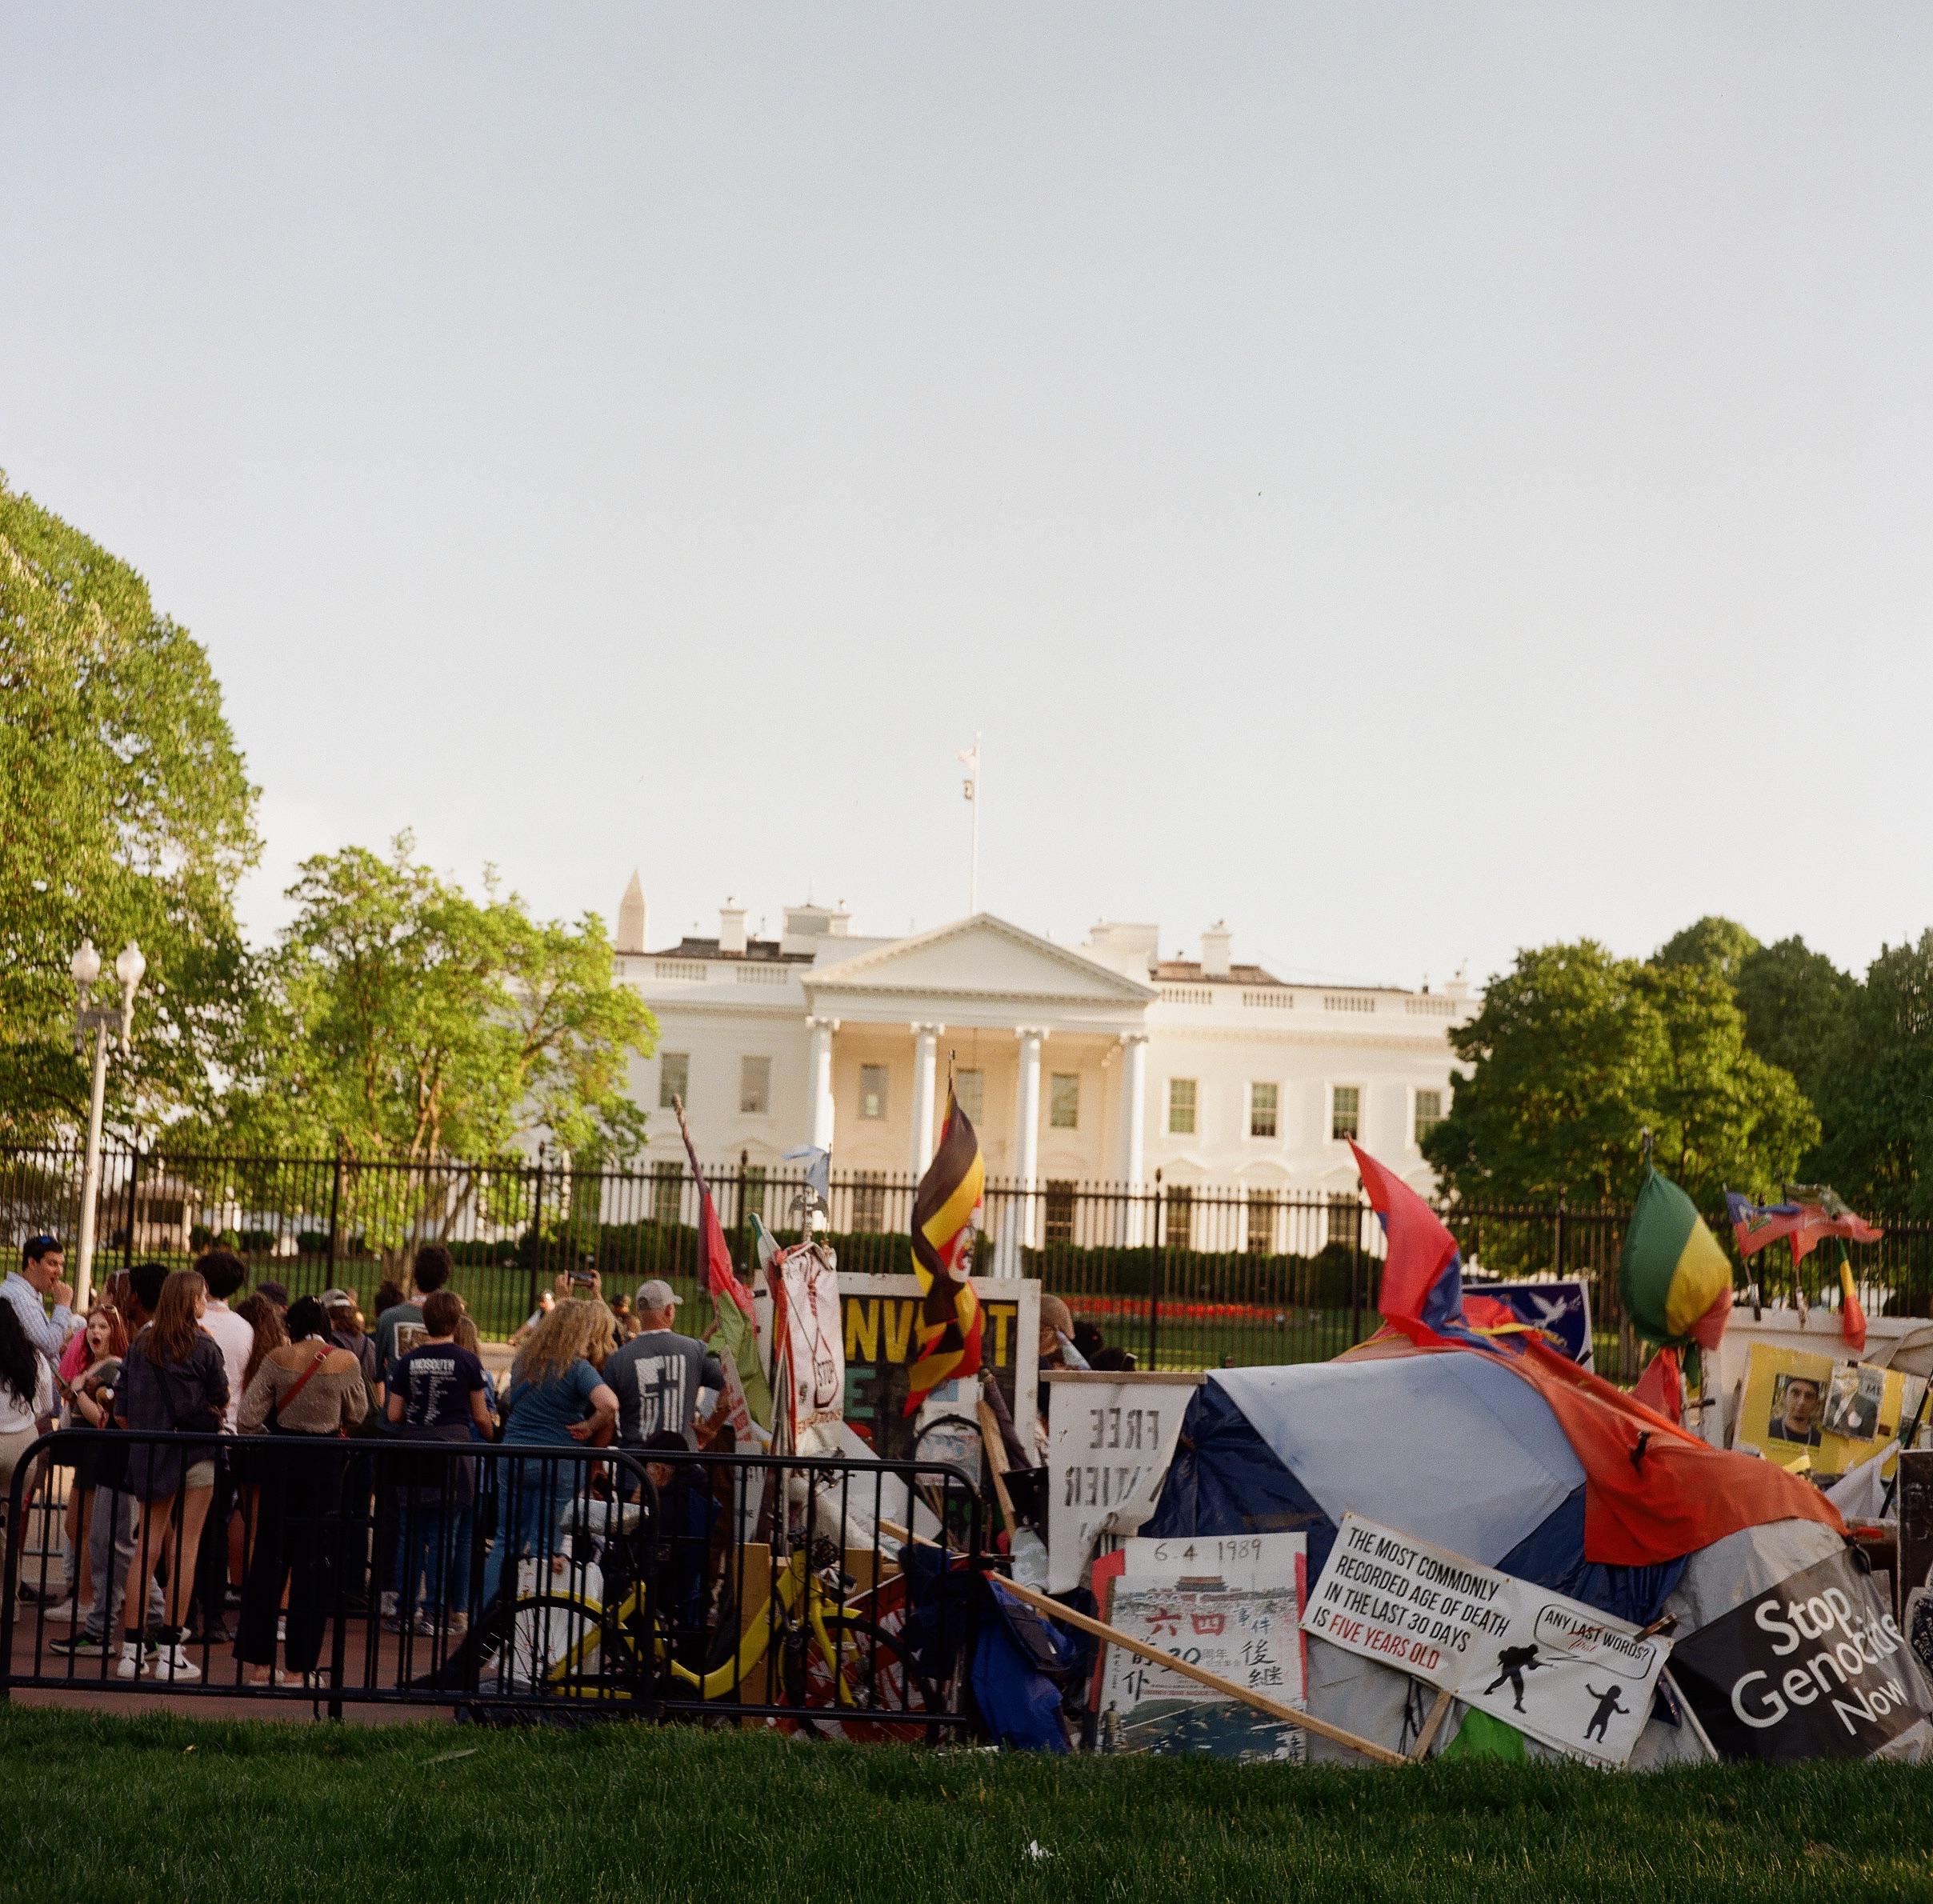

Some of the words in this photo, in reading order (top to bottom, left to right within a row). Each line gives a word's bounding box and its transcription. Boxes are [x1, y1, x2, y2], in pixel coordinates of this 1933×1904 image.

[1218, 1538, 1263, 1561] 1989
[1347, 1527, 1376, 1554] THE
[1375, 1537, 1419, 1570] MOST
[1417, 1556, 1501, 1601] COMMONLY
[1146, 1606, 1225, 1637] 六四
[1324, 1581, 1344, 1604] IN
[1343, 1588, 1373, 1615] THE
[1371, 1597, 1410, 1626] LAST
[1407, 1612, 1431, 1634] 30
[1429, 1621, 1471, 1653] DAYS
[1335, 1554, 1410, 1598] RECORDED
[1408, 1586, 1442, 1610] AGE
[1440, 1597, 1465, 1617] OF
[1460, 1604, 1511, 1638] DEATH
[1755, 1587, 1854, 1656] Stop
[1312, 1606, 1330, 1627] IS
[1328, 1613, 1364, 1642] FIVE
[1363, 1626, 1411, 1658] YEARS
[1409, 1642, 1442, 1670] OLD
[1544, 1610, 1572, 1630] ANY
[1569, 1620, 1601, 1642] LAST
[1602, 1632, 1651, 1662] WORDS?
[1731, 1606, 1904, 1729] Genocide
[1831, 1678, 1908, 1736] Now
